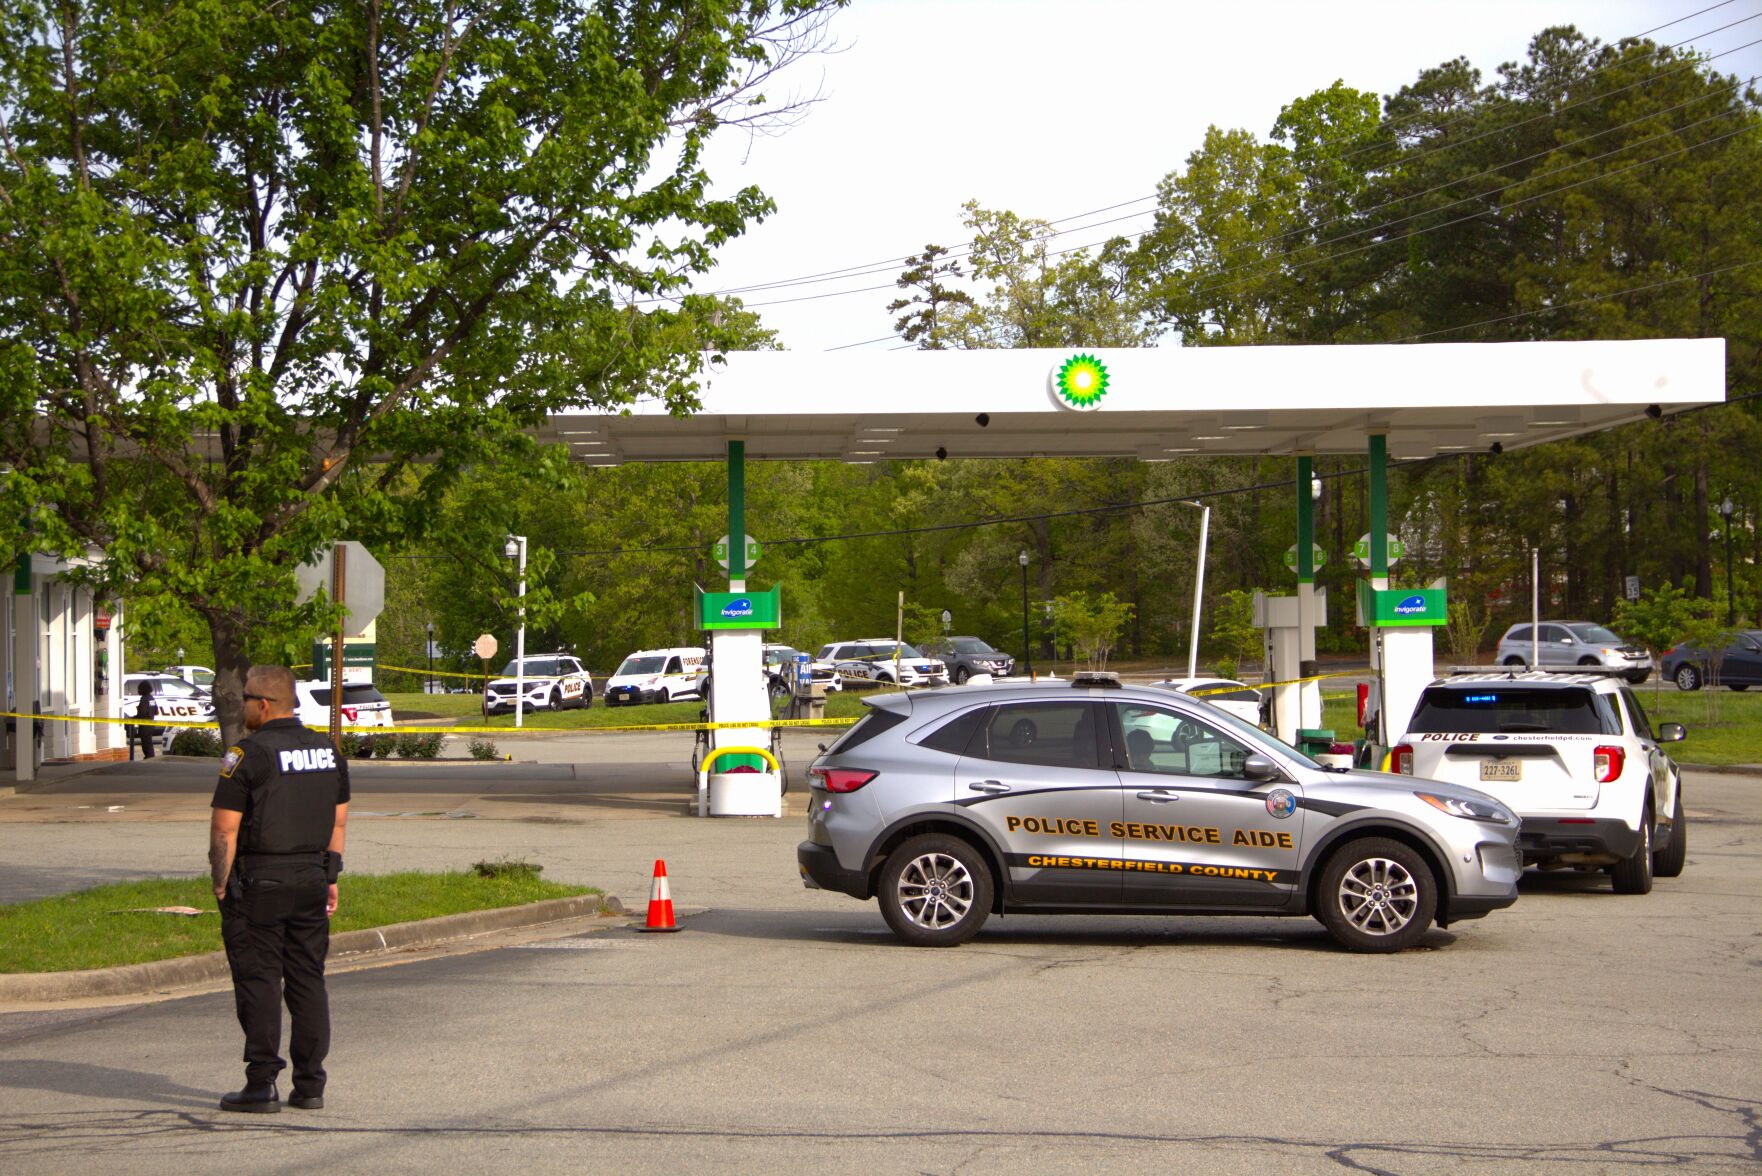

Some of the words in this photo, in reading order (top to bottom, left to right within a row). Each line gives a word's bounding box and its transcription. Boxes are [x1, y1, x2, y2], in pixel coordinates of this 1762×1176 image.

[717, 545, 723, 555] 3
[751, 545, 757, 555] 4
[1359, 544, 1365, 553] 7
[1393, 543, 1399, 553] 8
[564, 681, 581, 694] POLICE
[155, 706, 198, 717] LICE
[1420, 733, 1480, 742] POLICE
[280, 748, 336, 771] POLICE
[1006, 816, 1099, 836] POLICE
[1110, 822, 1220, 844] SERVICE
[1232, 830, 1294, 849] AIDE
[1028, 855, 1183, 874] CHESTERFIELD
[1189, 865, 1278, 882] COUNTY
